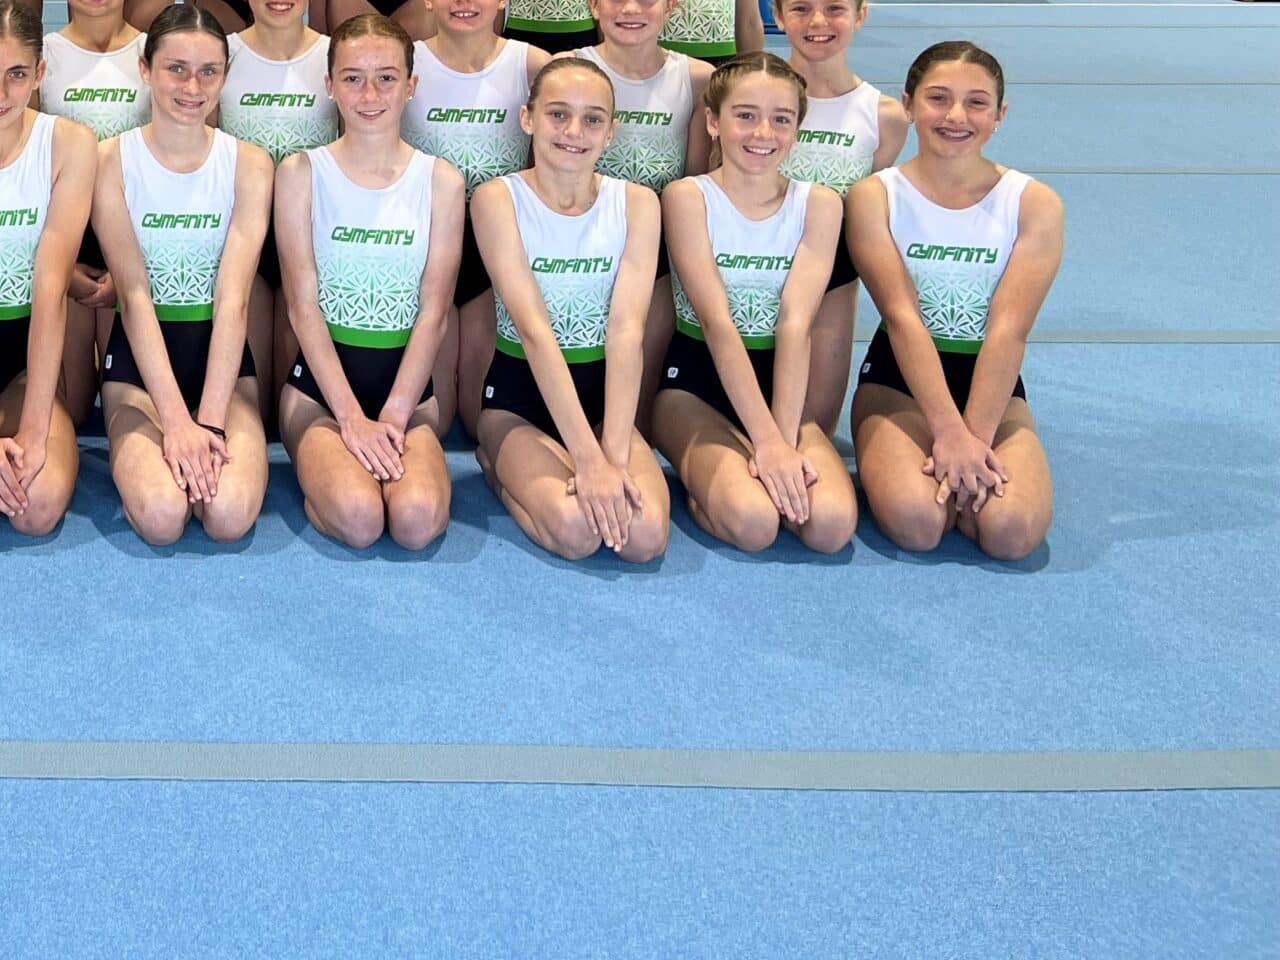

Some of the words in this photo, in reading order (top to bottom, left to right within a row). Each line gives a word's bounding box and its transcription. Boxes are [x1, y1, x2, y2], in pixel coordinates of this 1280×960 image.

[63, 87, 137, 102] GYMFINITY
[239, 92, 316, 108] GYMFINITY
[427, 107, 507, 124] GYMFINITY
[615, 110, 672, 126] MFINITY
[141, 212, 221, 229] GYMFINITY
[331, 226, 414, 245] GYMFINITY
[715, 252, 794, 270] GYMFINITY
[906, 242, 998, 264] GYMFINITY
[531, 256, 612, 273] GYMFINITY
